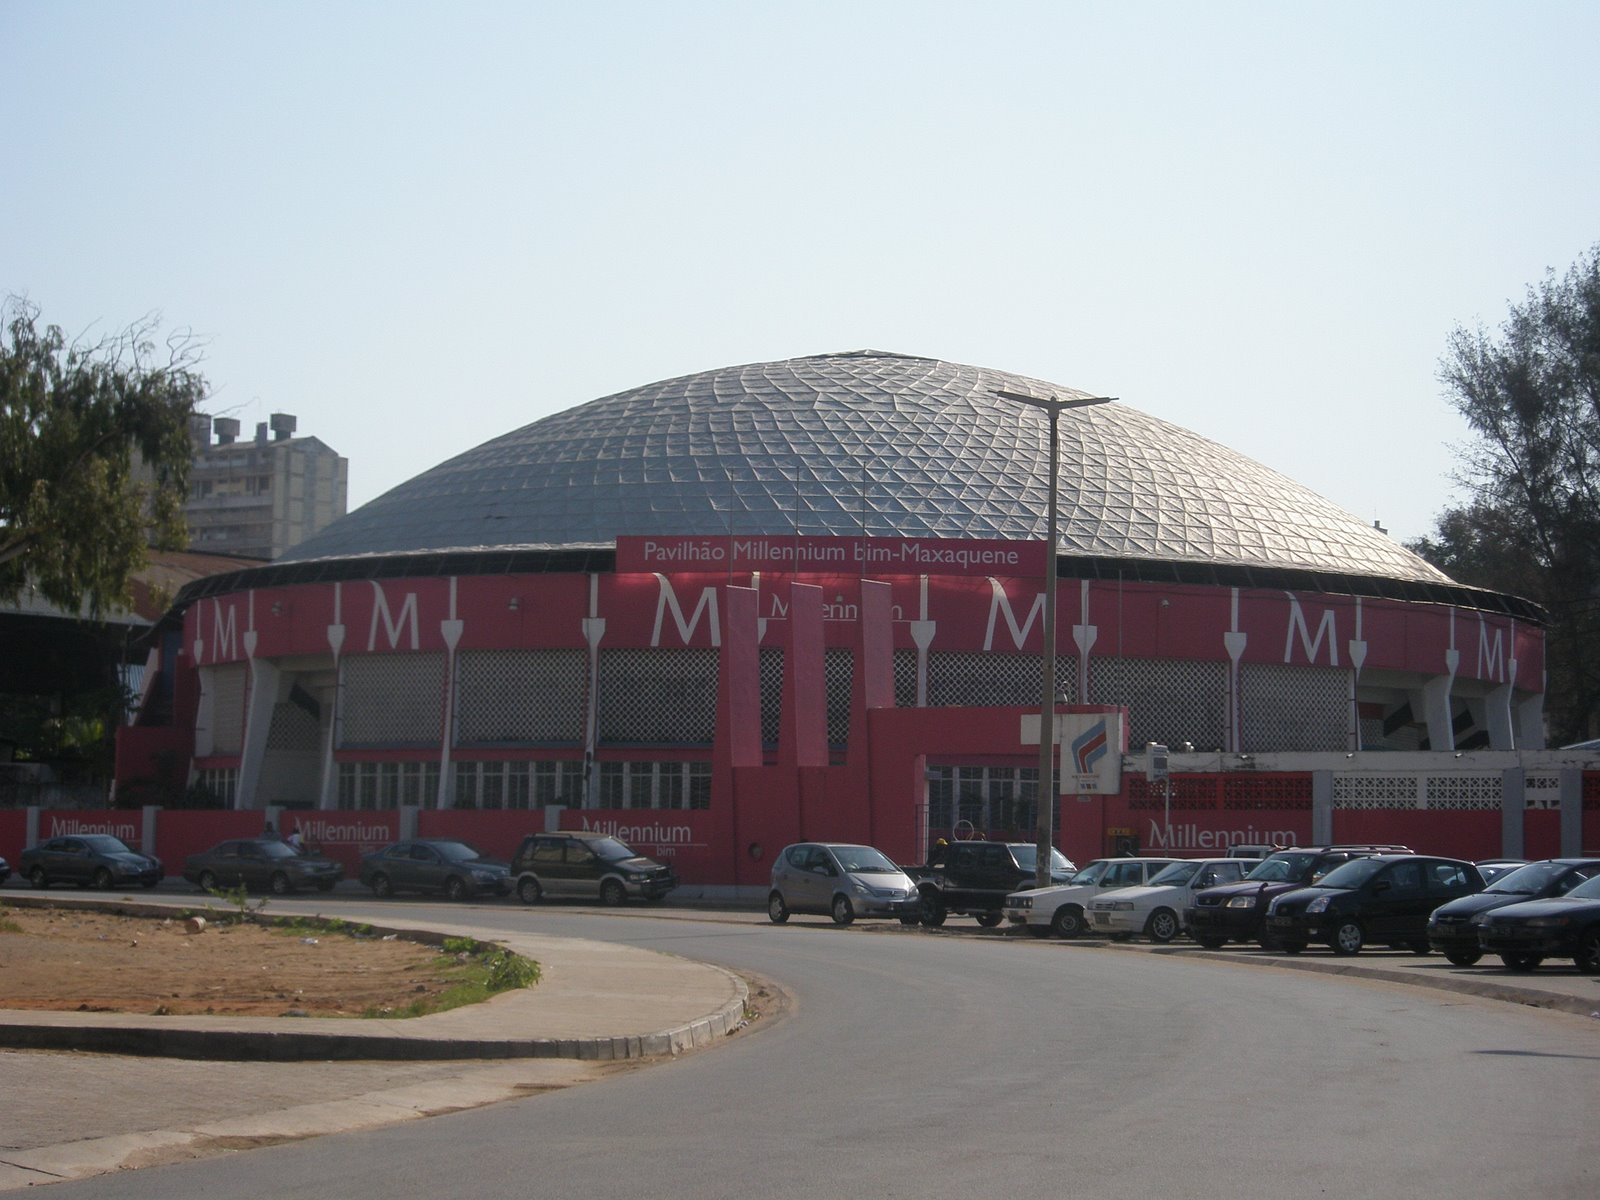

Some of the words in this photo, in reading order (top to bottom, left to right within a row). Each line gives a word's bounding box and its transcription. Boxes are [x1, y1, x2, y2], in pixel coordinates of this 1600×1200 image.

[644, 541, 725, 561] Pavilhão
[733, 541, 845, 561] Millennium
[854, 542, 1019, 569] bim-Maxaquene
[212, 596, 237, 663] M
[367, 579, 419, 651] M
[650, 572, 721, 647] M
[982, 576, 1047, 651] M
[1283, 590, 1339, 666] M
[1476, 611, 1504, 683] M
[51, 815, 135, 839] Millennium
[294, 815, 390, 841] Millennium
[582, 815, 691, 843] Millennium
[656, 845, 676, 857] bim
[1148, 817, 1297, 849] Millennium
